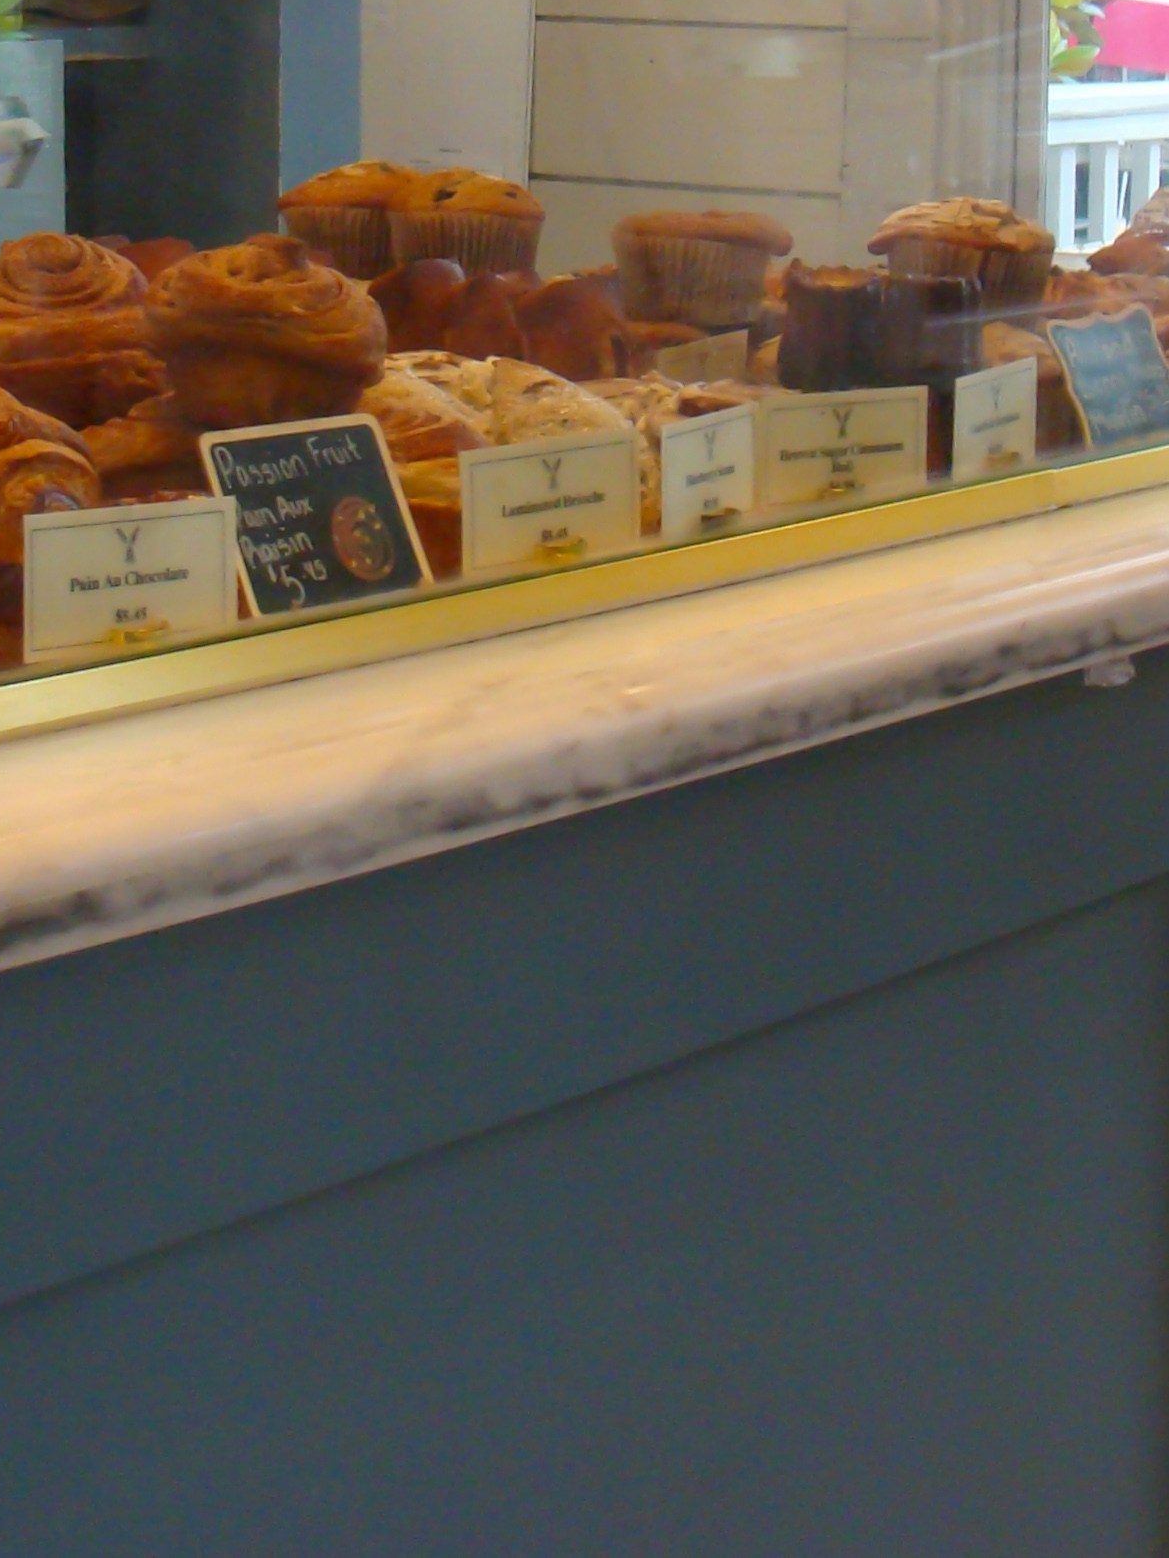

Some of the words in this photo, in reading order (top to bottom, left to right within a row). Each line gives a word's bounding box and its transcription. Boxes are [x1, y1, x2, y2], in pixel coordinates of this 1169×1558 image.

[213, 445, 309, 490] Passion
[306, 433, 362, 468] Fruit
[275, 495, 314, 521] Aux
[70, 576, 100, 592] Pain
[124, 568, 190, 586] Chocolate
